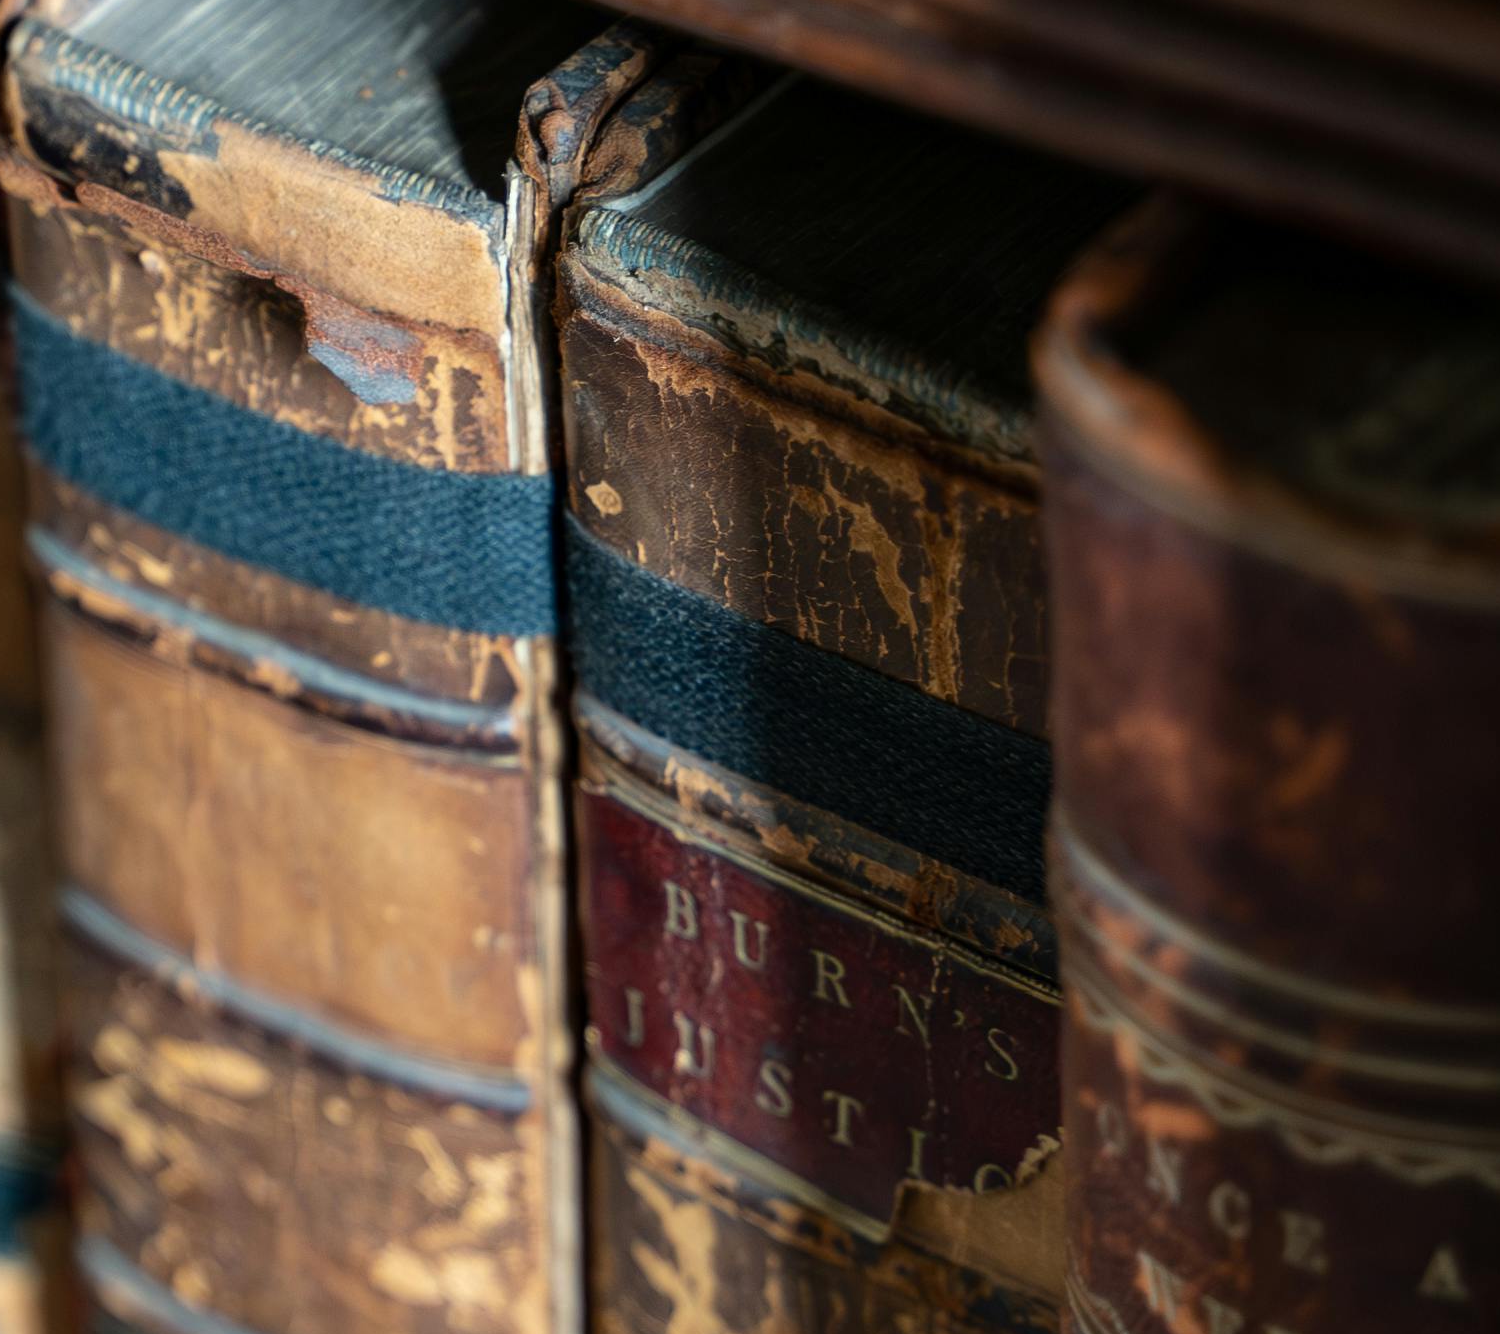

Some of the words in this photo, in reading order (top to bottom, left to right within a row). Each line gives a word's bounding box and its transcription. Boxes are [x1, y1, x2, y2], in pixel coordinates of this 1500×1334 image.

[663, 880, 1019, 1082] BURN'S
[1095, 1099, 1329, 1275] ONCE
[1415, 1241, 1471, 1303] A
